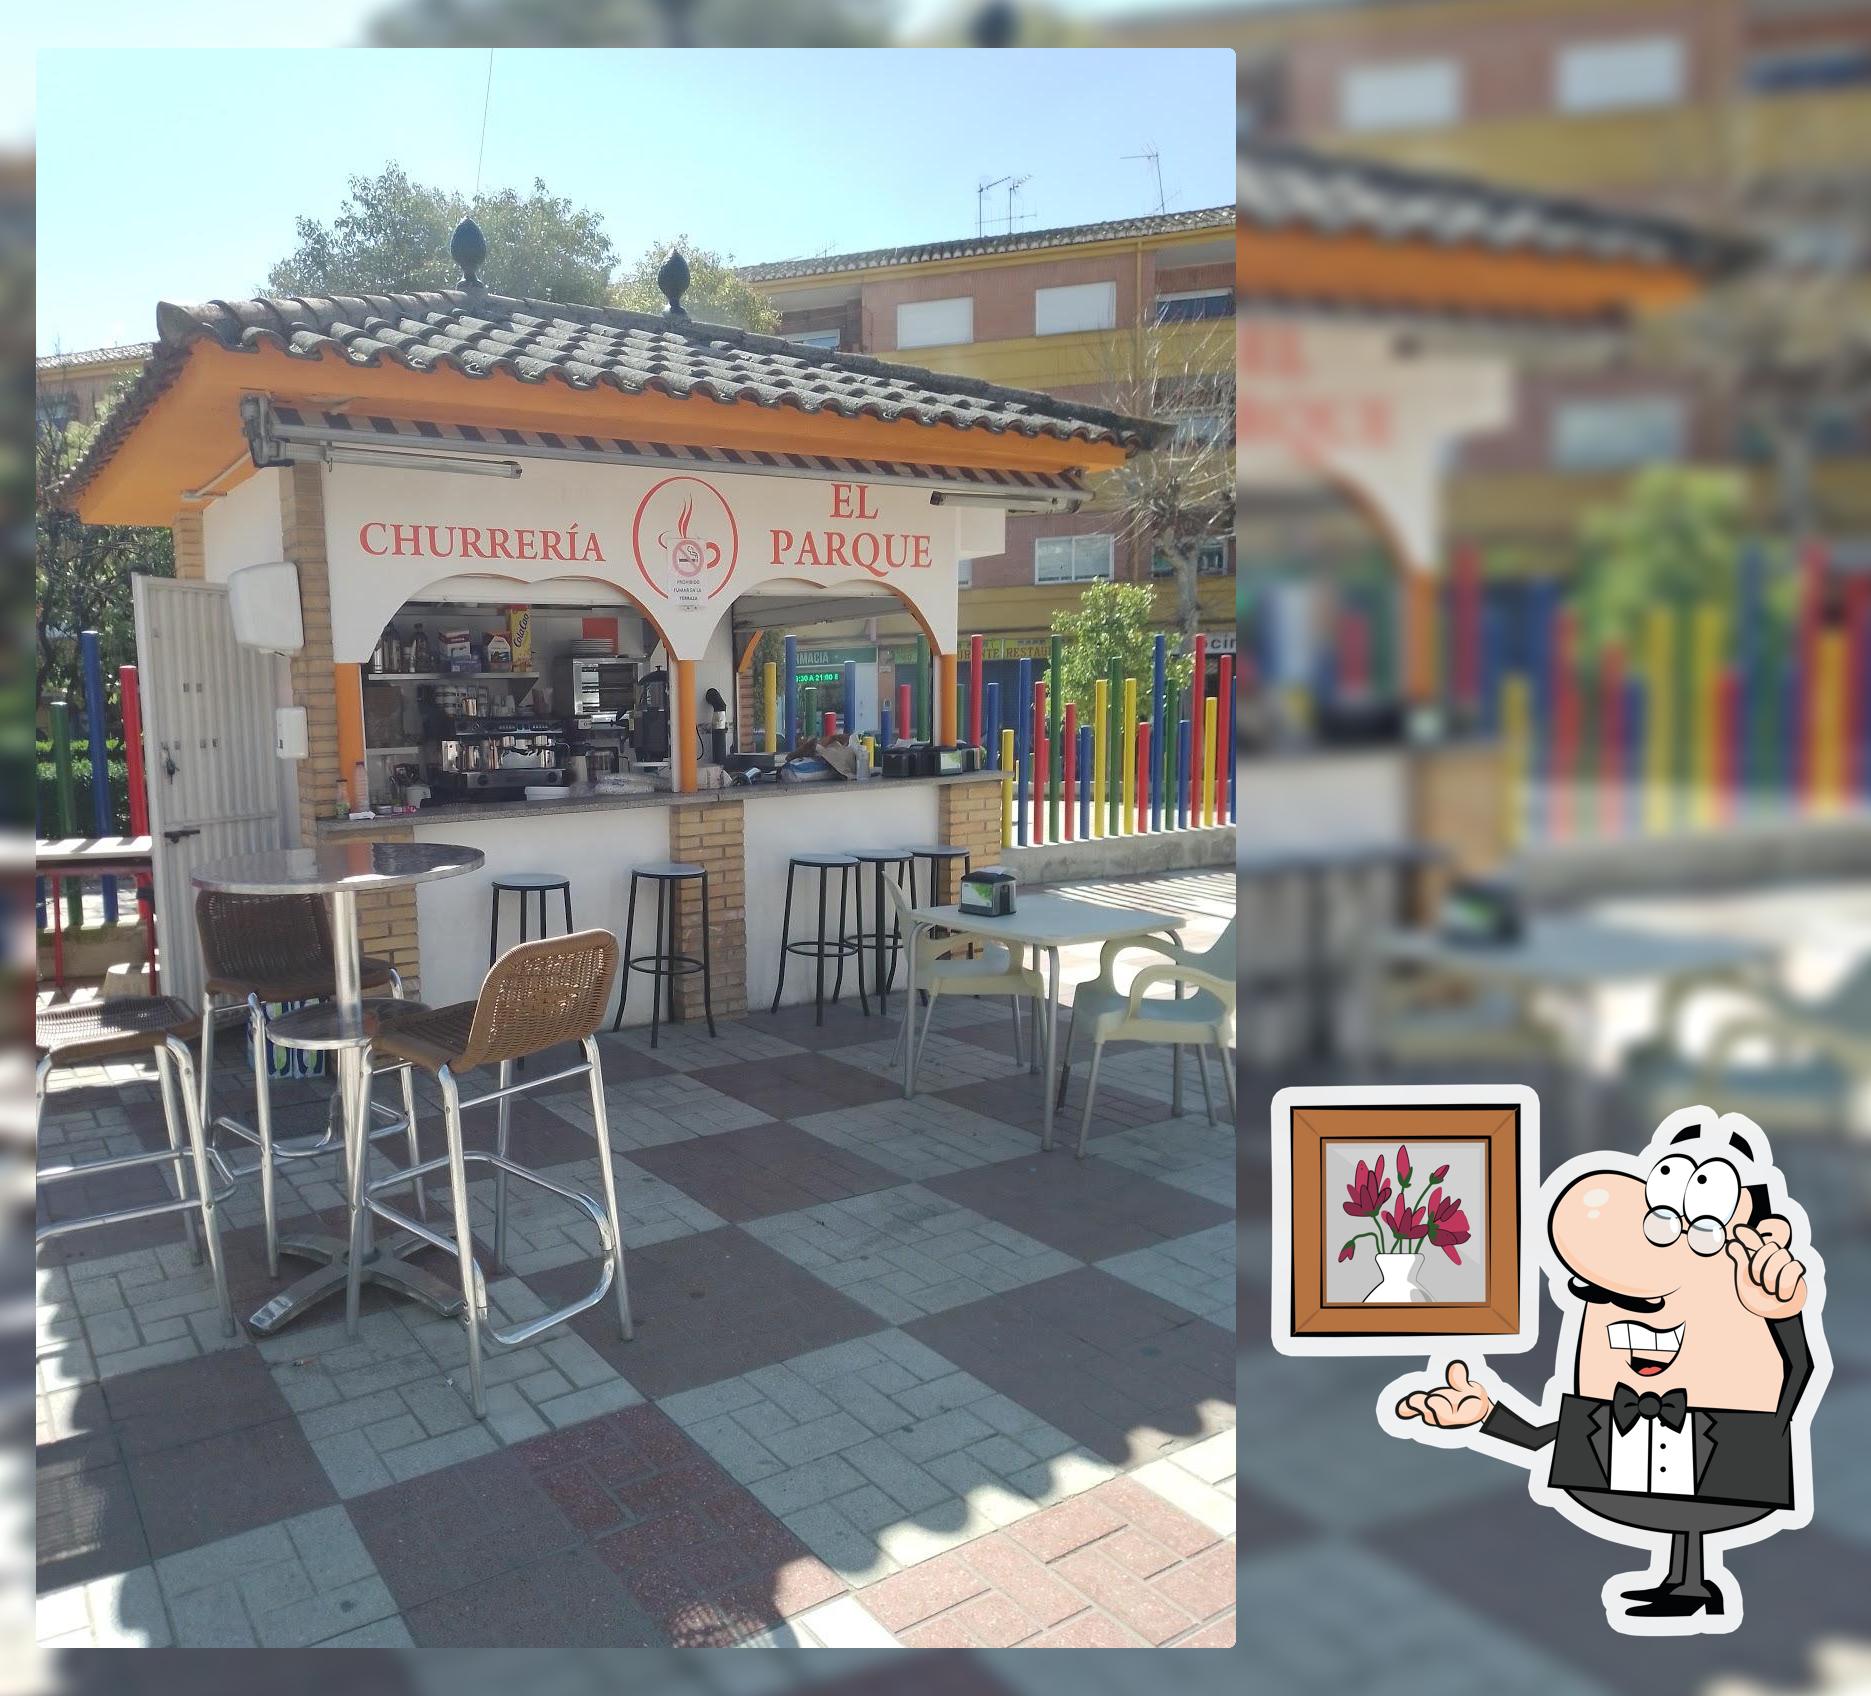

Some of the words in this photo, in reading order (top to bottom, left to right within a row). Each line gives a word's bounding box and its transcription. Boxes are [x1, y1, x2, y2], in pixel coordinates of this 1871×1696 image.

[830, 483, 878, 519] EL
[359, 522, 606, 561] CHURRERÍA
[769, 529, 932, 577] PARQUE
[513, 612, 530, 648] ColaCao
